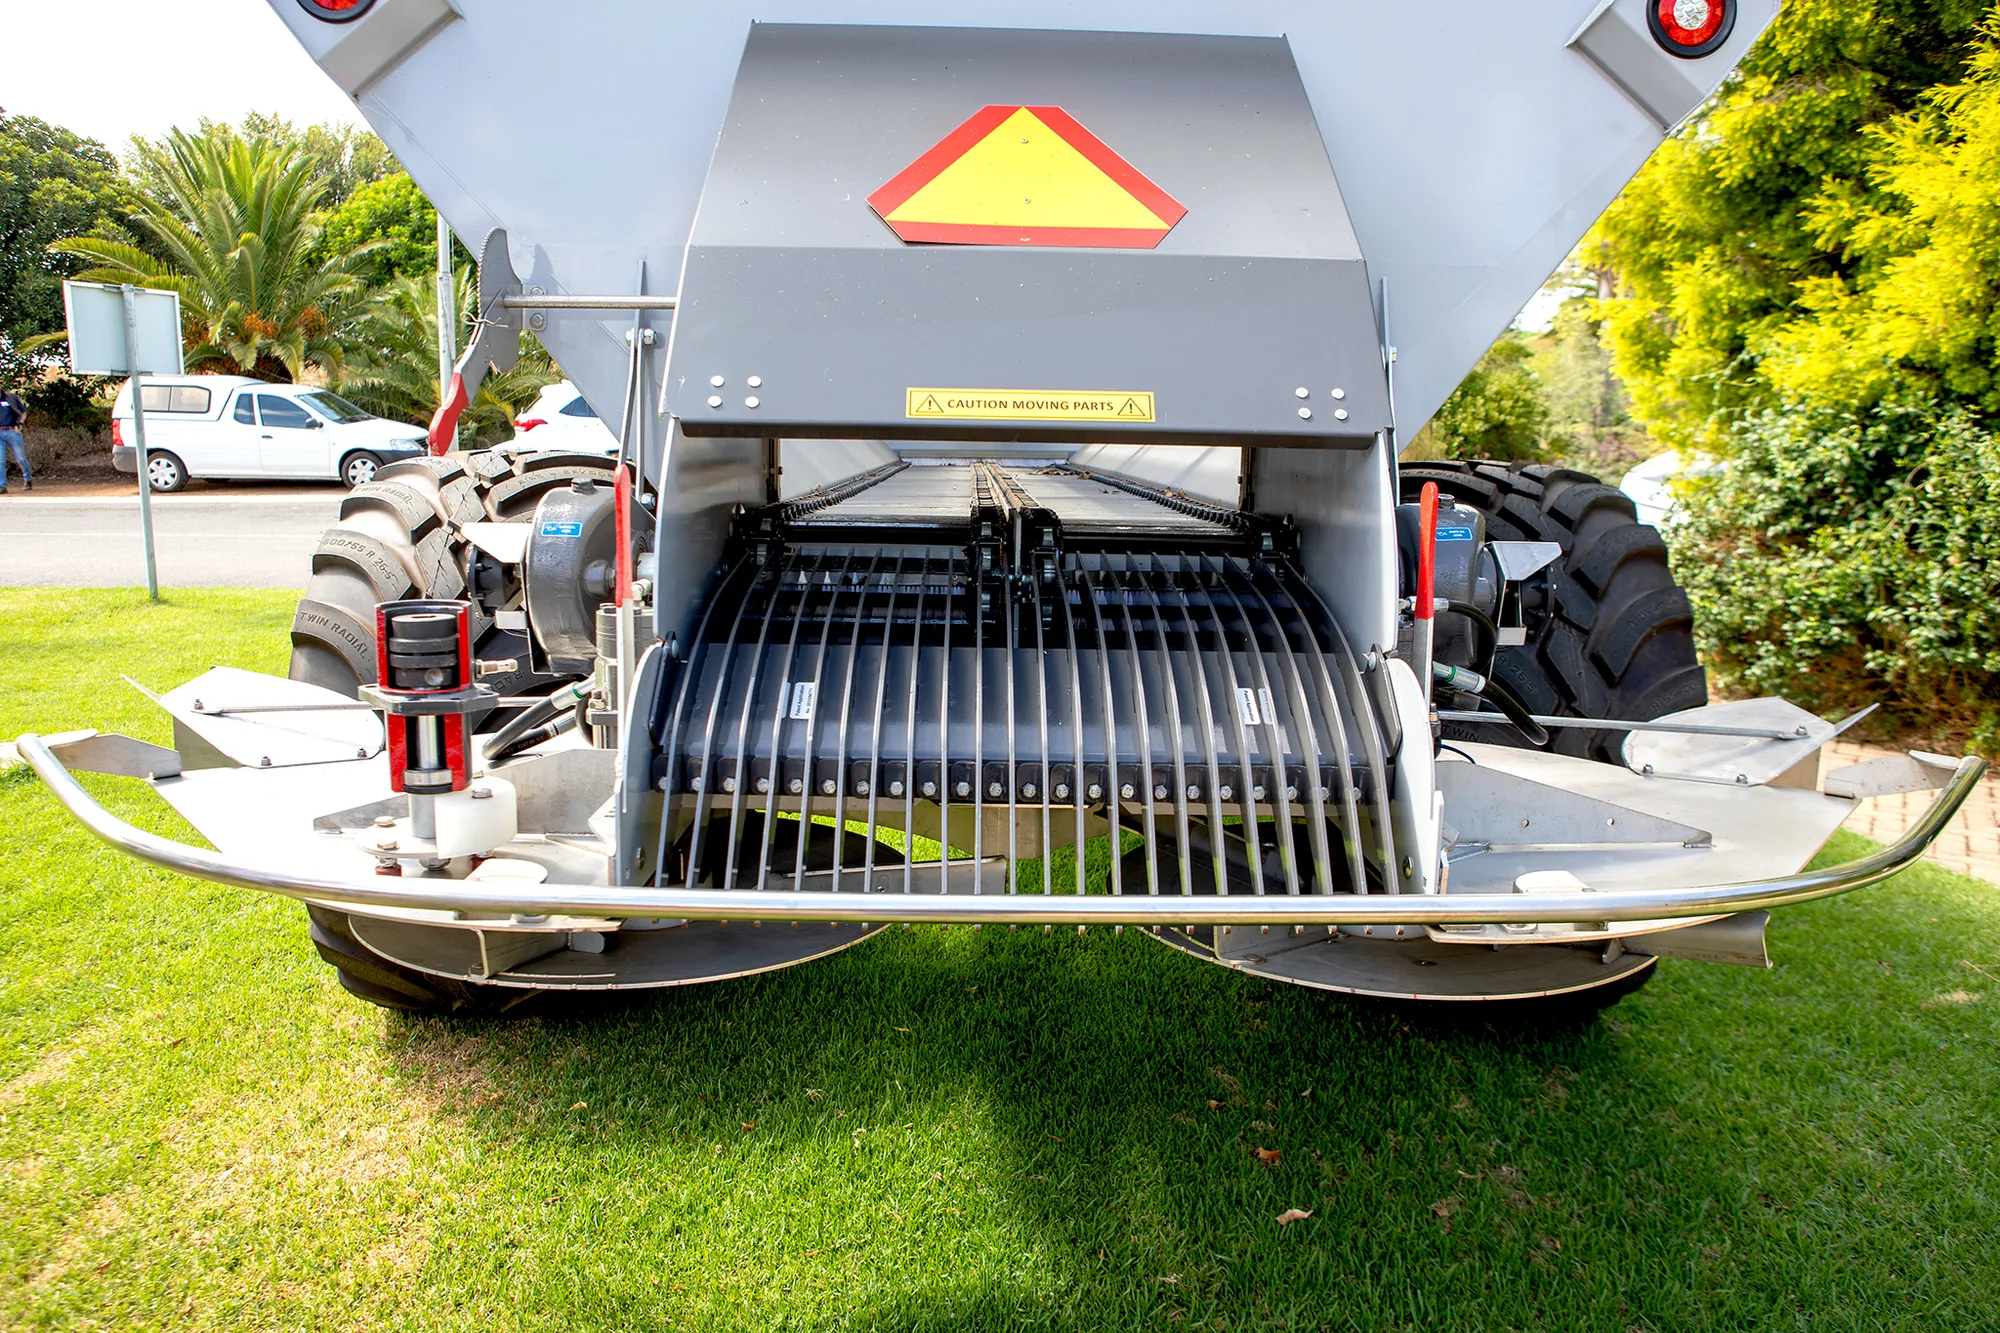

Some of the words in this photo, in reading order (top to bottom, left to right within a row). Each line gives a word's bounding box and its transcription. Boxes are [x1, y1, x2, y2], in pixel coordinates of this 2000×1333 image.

[947, 399, 1008, 409] CAUTION
[1012, 400, 1069, 410] MOVING
[1073, 401, 1114, 411] PARTS
[365, 550, 376, 559] R
[300, 611, 330, 627] TWIN
[330, 622, 368, 659] RADIAL
[1497, 655, 1508, 665] R
[1442, 724, 1480, 742] TWIN
